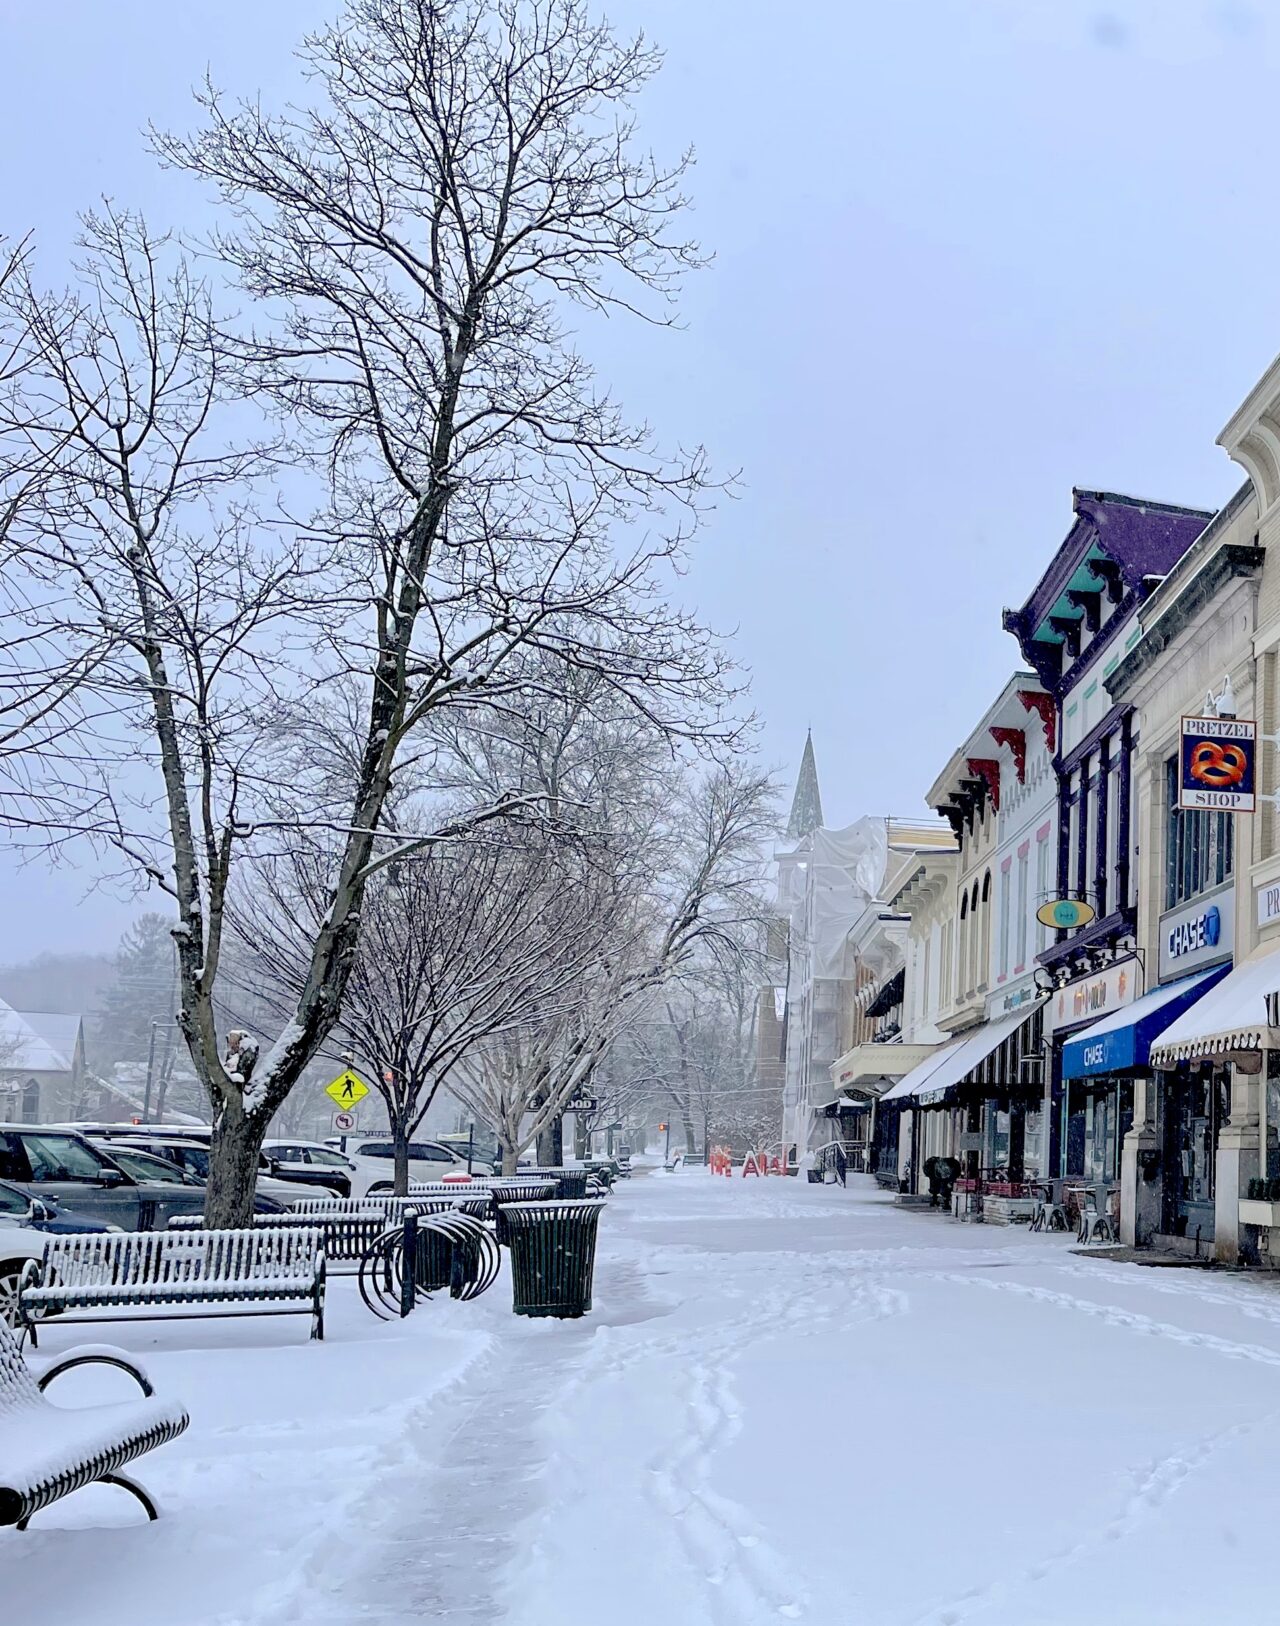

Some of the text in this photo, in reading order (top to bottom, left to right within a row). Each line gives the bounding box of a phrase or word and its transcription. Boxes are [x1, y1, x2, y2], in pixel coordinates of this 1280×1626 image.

[1186, 720, 1253, 738] PRETZEL
[1195, 792, 1241, 807] SHOP
[1168, 914, 1207, 959] CHASE
[1084, 1043, 1103, 1067] CHASE
[530, 1100, 592, 1109] EOOD
